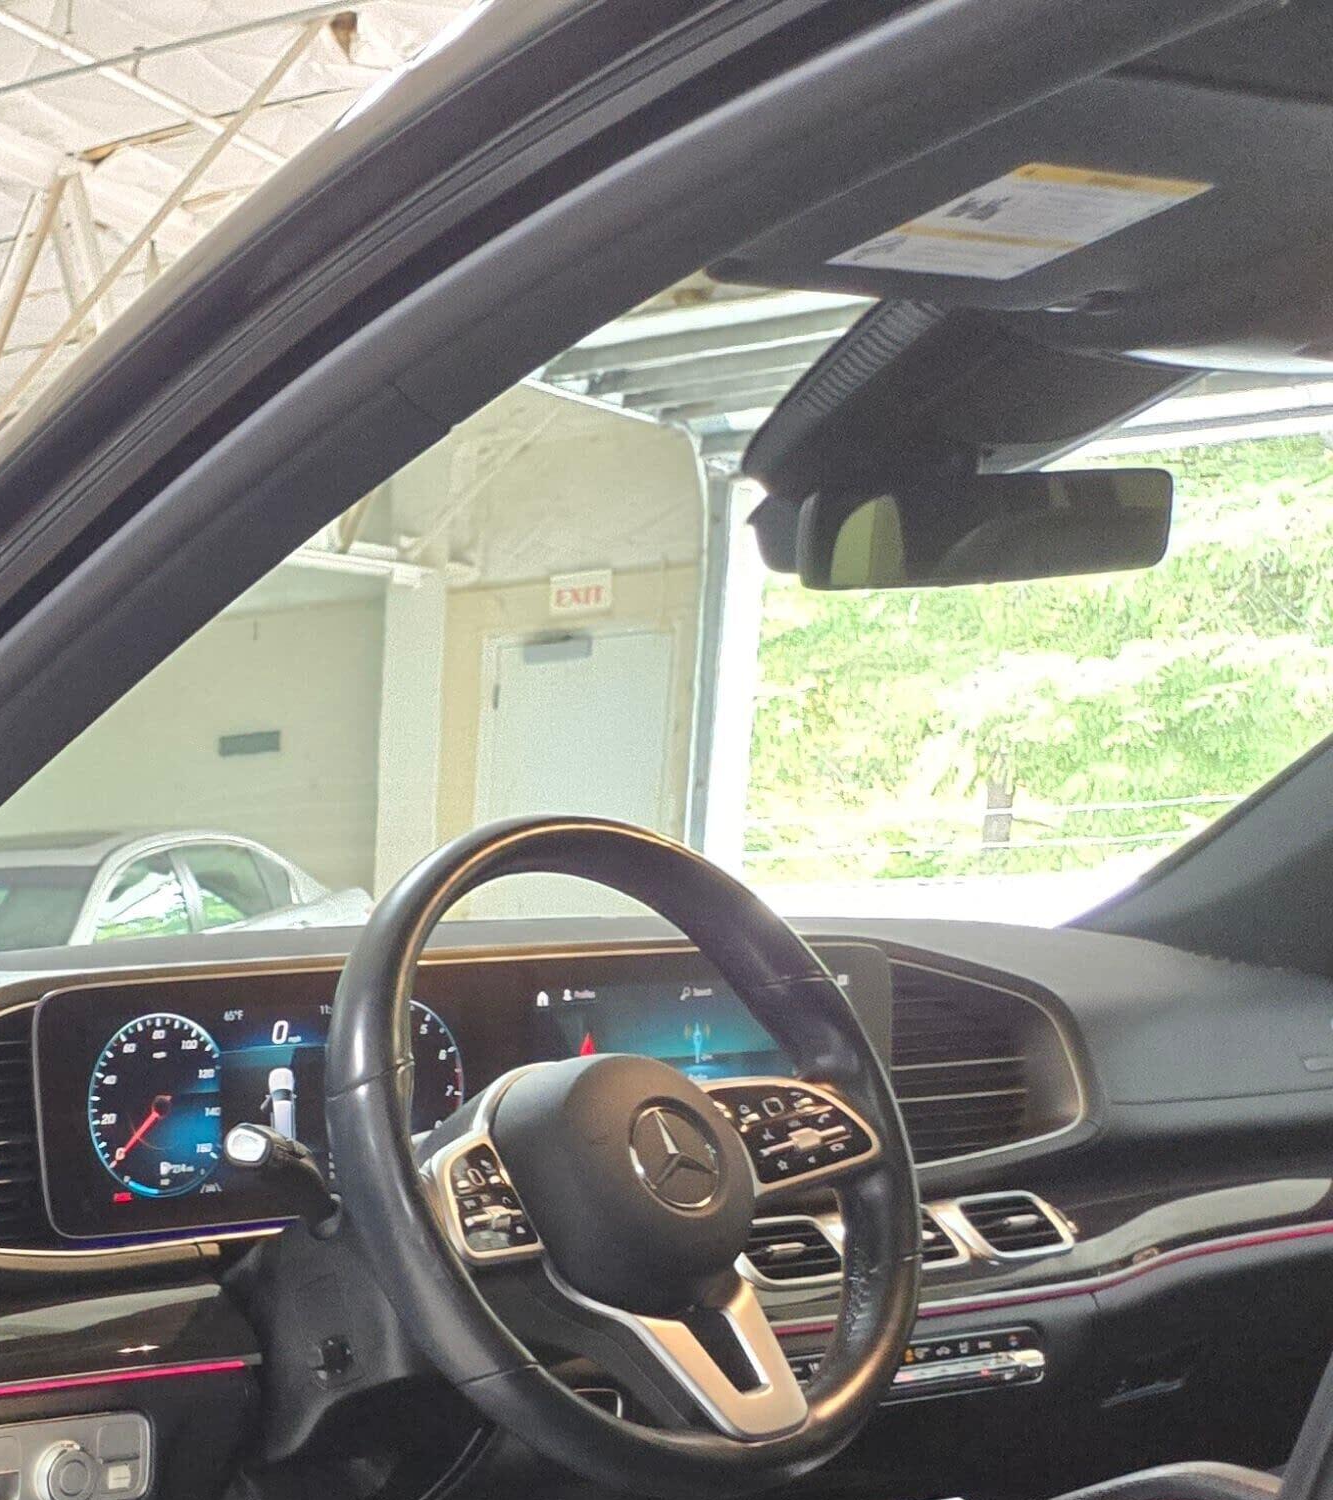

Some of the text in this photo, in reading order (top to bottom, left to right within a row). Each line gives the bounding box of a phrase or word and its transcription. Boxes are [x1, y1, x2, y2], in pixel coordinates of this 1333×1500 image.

[555, 585, 604, 608] EXIT
[272, 1020, 289, 1044] 0
[419, 1023, 429, 1035] 5
[181, 1039, 199, 1050] 100
[205, 1106, 222, 1117] 140
[100, 1113, 117, 1125] 20
